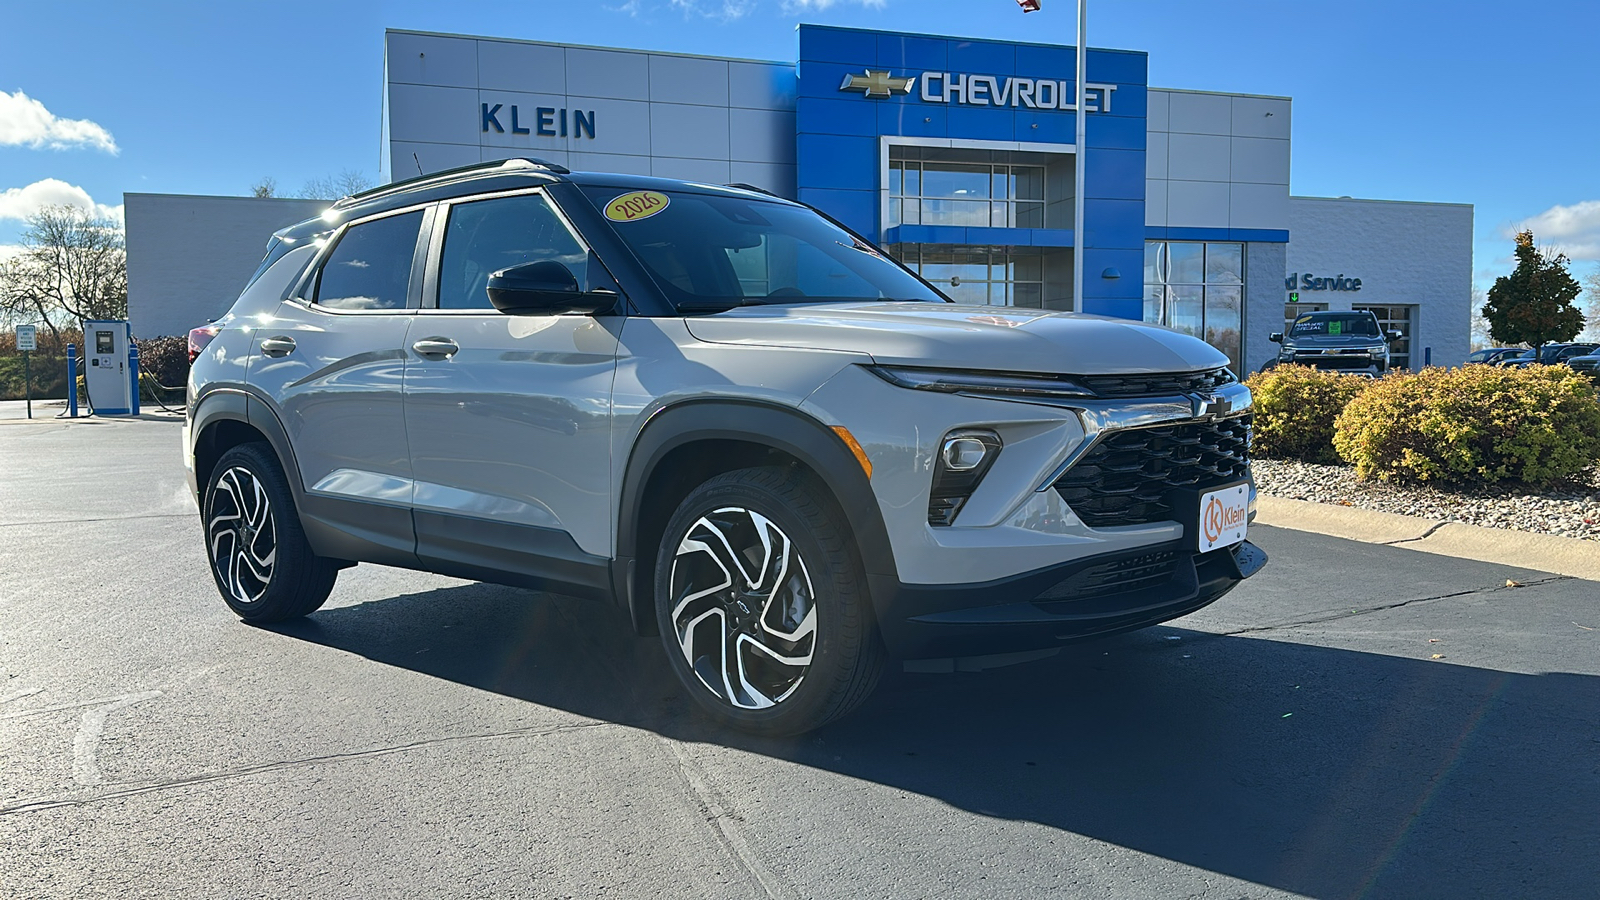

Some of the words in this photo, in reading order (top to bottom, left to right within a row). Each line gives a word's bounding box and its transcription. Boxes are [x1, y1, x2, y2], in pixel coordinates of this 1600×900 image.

[921, 71, 1118, 112] CHEVROLET
[481, 102, 596, 139] KLEIN
[615, 192, 660, 218] 2026
[1301, 273, 1362, 291] Service
[1224, 504, 1245, 526] Klein
